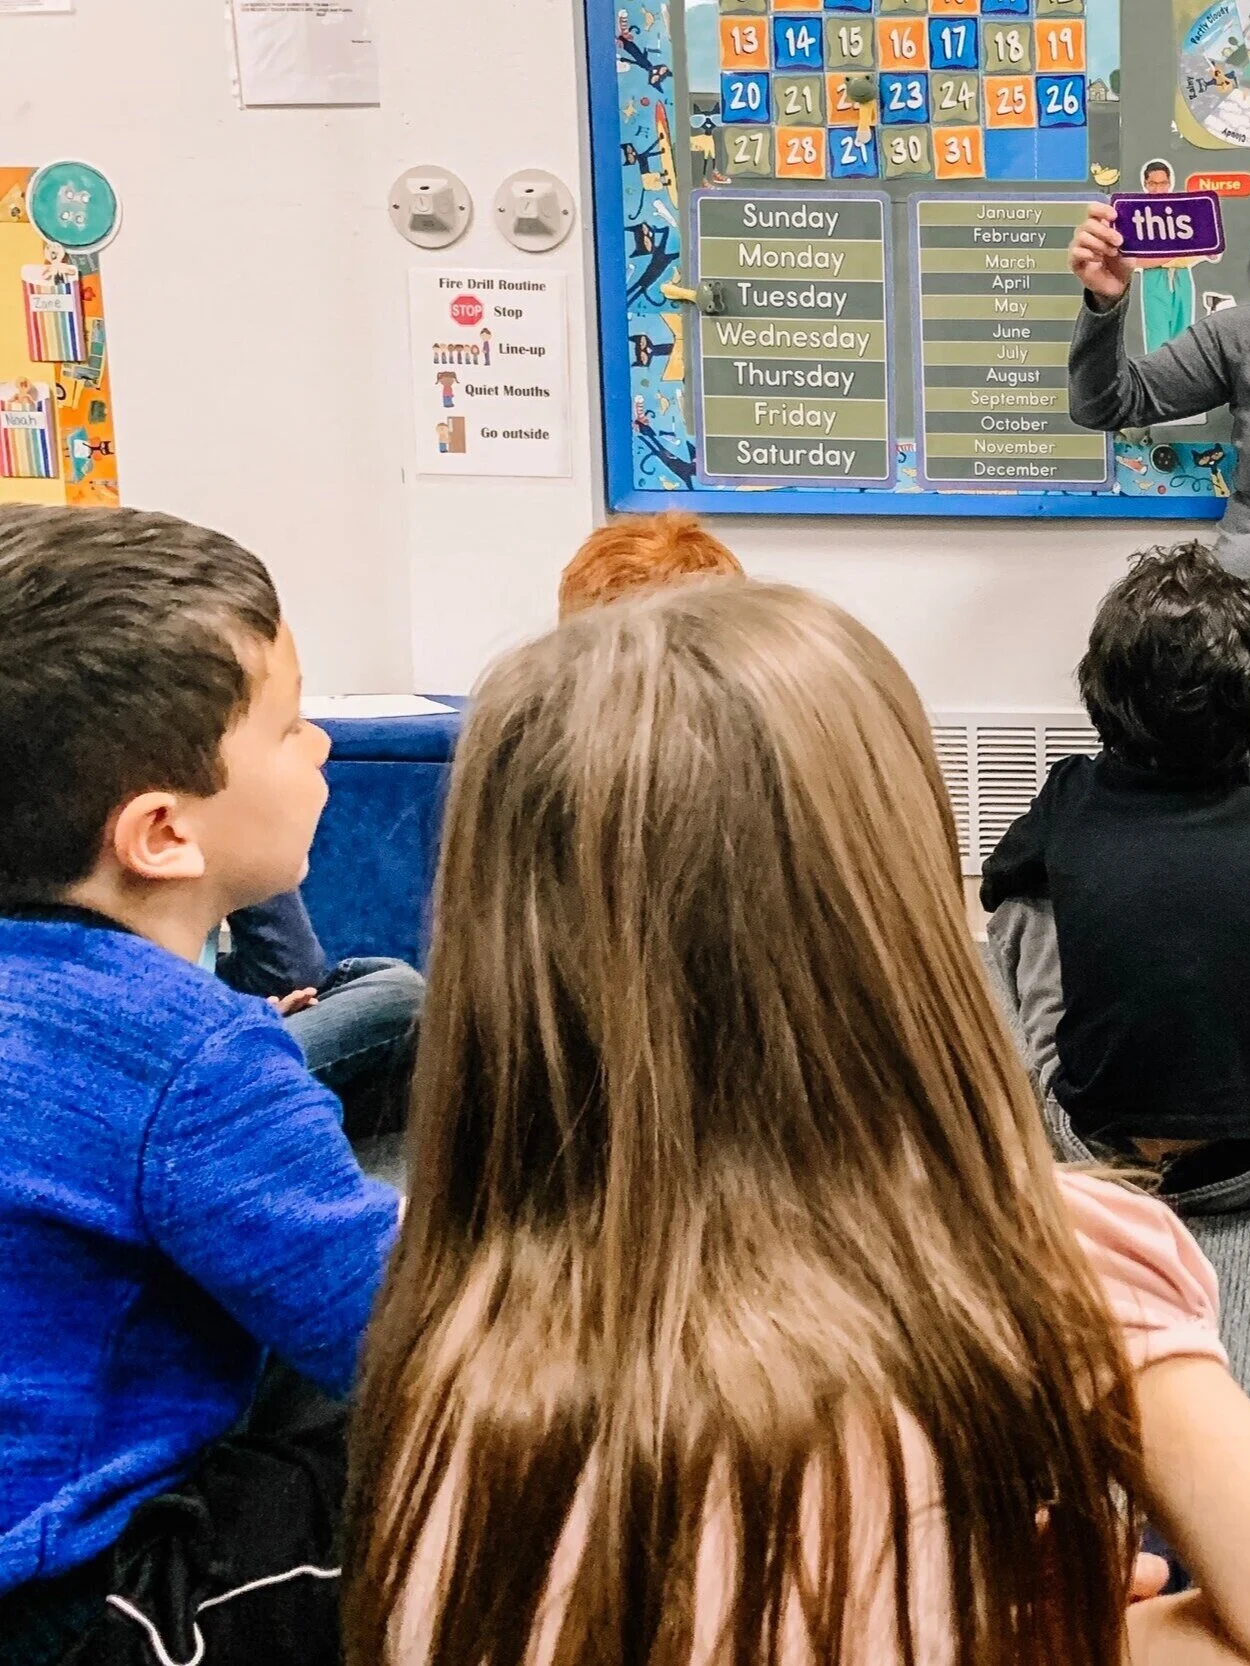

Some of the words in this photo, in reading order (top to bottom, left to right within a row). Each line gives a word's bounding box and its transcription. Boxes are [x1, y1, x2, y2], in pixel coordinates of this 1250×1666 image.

[1190, 22, 1209, 45] Partly
[1208, 5, 1230, 26] Cloudy
[730, 27, 760, 54] 13
[785, 26, 816, 58] 14
[838, 27, 863, 56] 15
[890, 27, 917, 59] 16
[941, 26, 967, 58] 17
[993, 30, 1024, 61] 18
[1047, 28, 1074, 60] 19
[1186, 76, 1198, 101] Rainy
[730, 82, 760, 110] 20
[784, 86, 813, 114] 21
[890, 82, 922, 112] 23
[940, 80, 976, 112] 24
[995, 86, 1027, 116] 25
[1047, 84, 1077, 116] 26
[1221, 128, 1247, 143] Cloudy
[734, 133, 763, 165] 27
[787, 137, 817, 165] 28
[891, 138, 921, 165] 30
[944, 137, 973, 165] 31
[1199, 178, 1242, 190] Nurse
[743, 203, 839, 236] Sunday
[976, 206, 1043, 224] January
[1132, 206, 1195, 241] this
[973, 228, 1047, 247] February
[738, 243, 846, 276] Monday
[985, 254, 1036, 269] March
[439, 278, 463, 289] Fire
[467, 278, 494, 290] Drill
[499, 280, 547, 291] Routine
[992, 275, 1031, 294] April
[737, 282, 848, 316] Tuesday
[994, 299, 1028, 317] May
[451, 304, 482, 317] STOP
[494, 306, 523, 319] Stop
[716, 322, 871, 357] Wednesday
[992, 324, 1031, 339] June
[499, 343, 546, 357] Line-up
[996, 345, 1029, 364] July
[734, 361, 856, 396] Thursday
[986, 368, 1041, 386] August
[465, 384, 499, 398] Quiet
[503, 385, 550, 398] Mouths
[970, 390, 1057, 409] September
[5, 414, 37, 426] Noah
[754, 402, 837, 434] Friday
[981, 416, 1049, 432] October
[480, 427, 498, 439] Go
[503, 428, 550, 440] outside
[737, 440, 856, 473] Saturday
[974, 440, 1056, 455] November
[974, 462, 1057, 477] December
